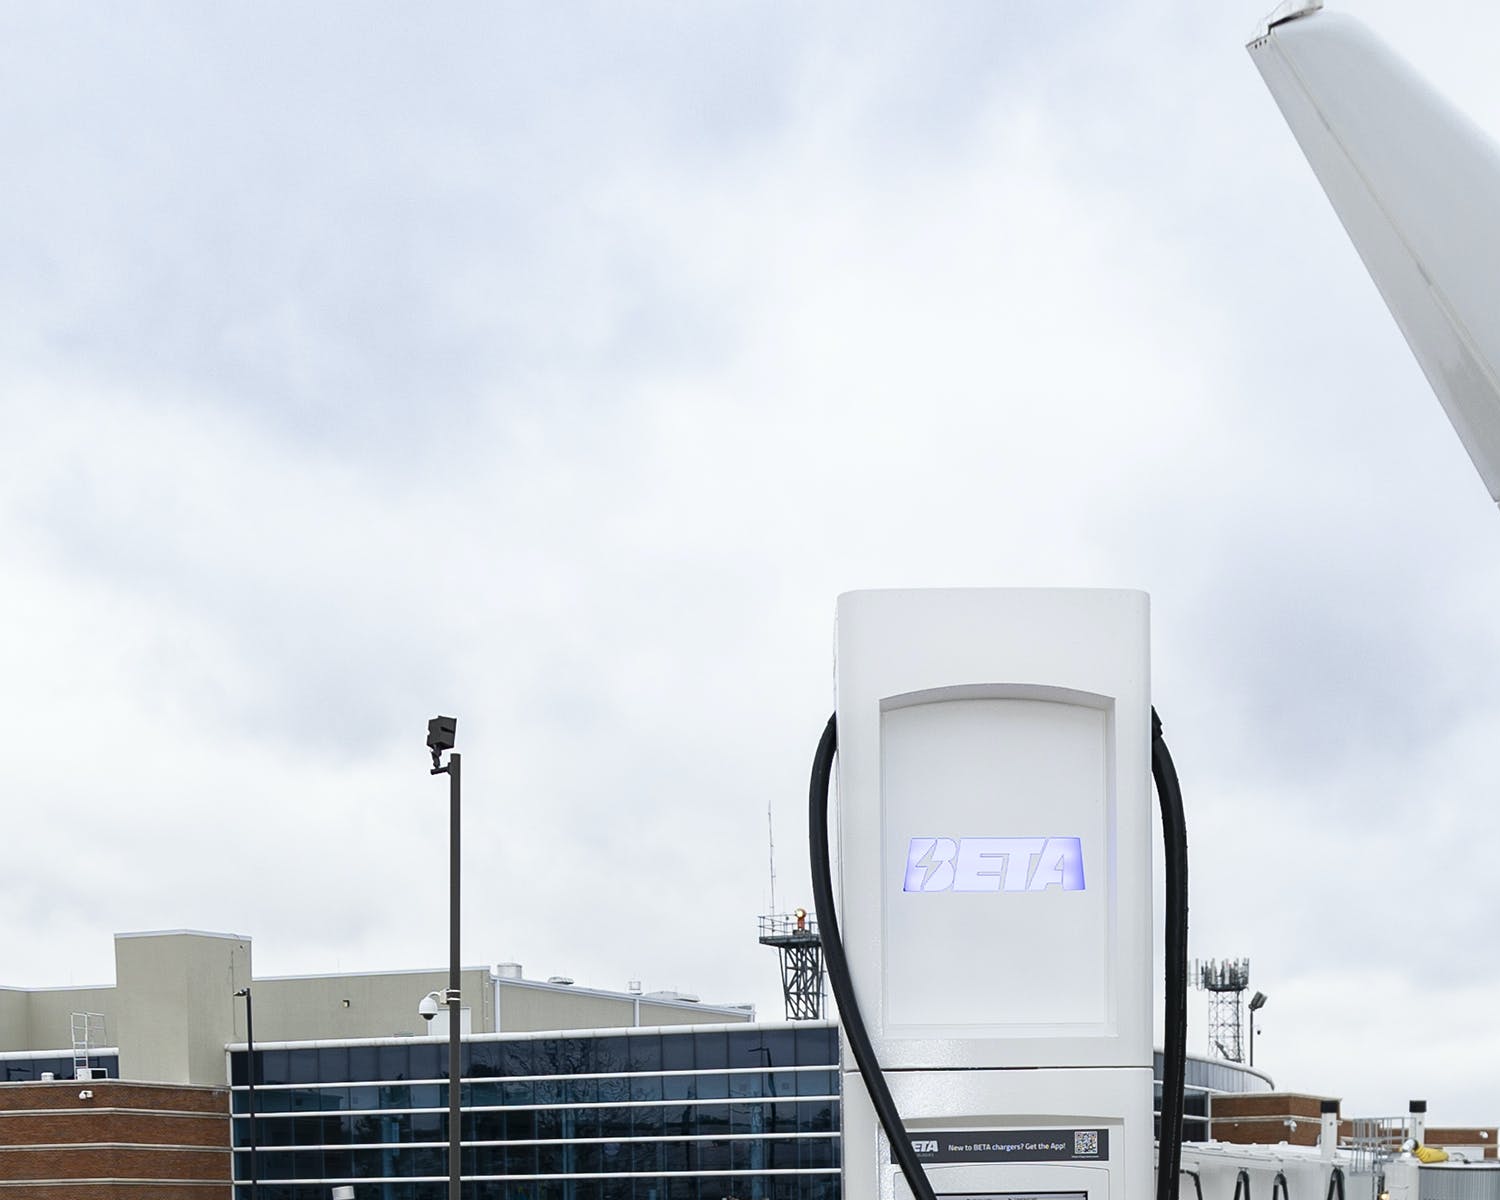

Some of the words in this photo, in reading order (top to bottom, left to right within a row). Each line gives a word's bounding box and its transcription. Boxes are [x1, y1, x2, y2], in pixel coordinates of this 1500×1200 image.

[903, 837, 1085, 892] BETA
[911, 1140, 939, 1153] ETA
[973, 1143, 991, 1151] BETA
[992, 1143, 1024, 1152] chargers?
[1038, 1142, 1049, 1150] the
[1050, 1142, 1066, 1151] App!
